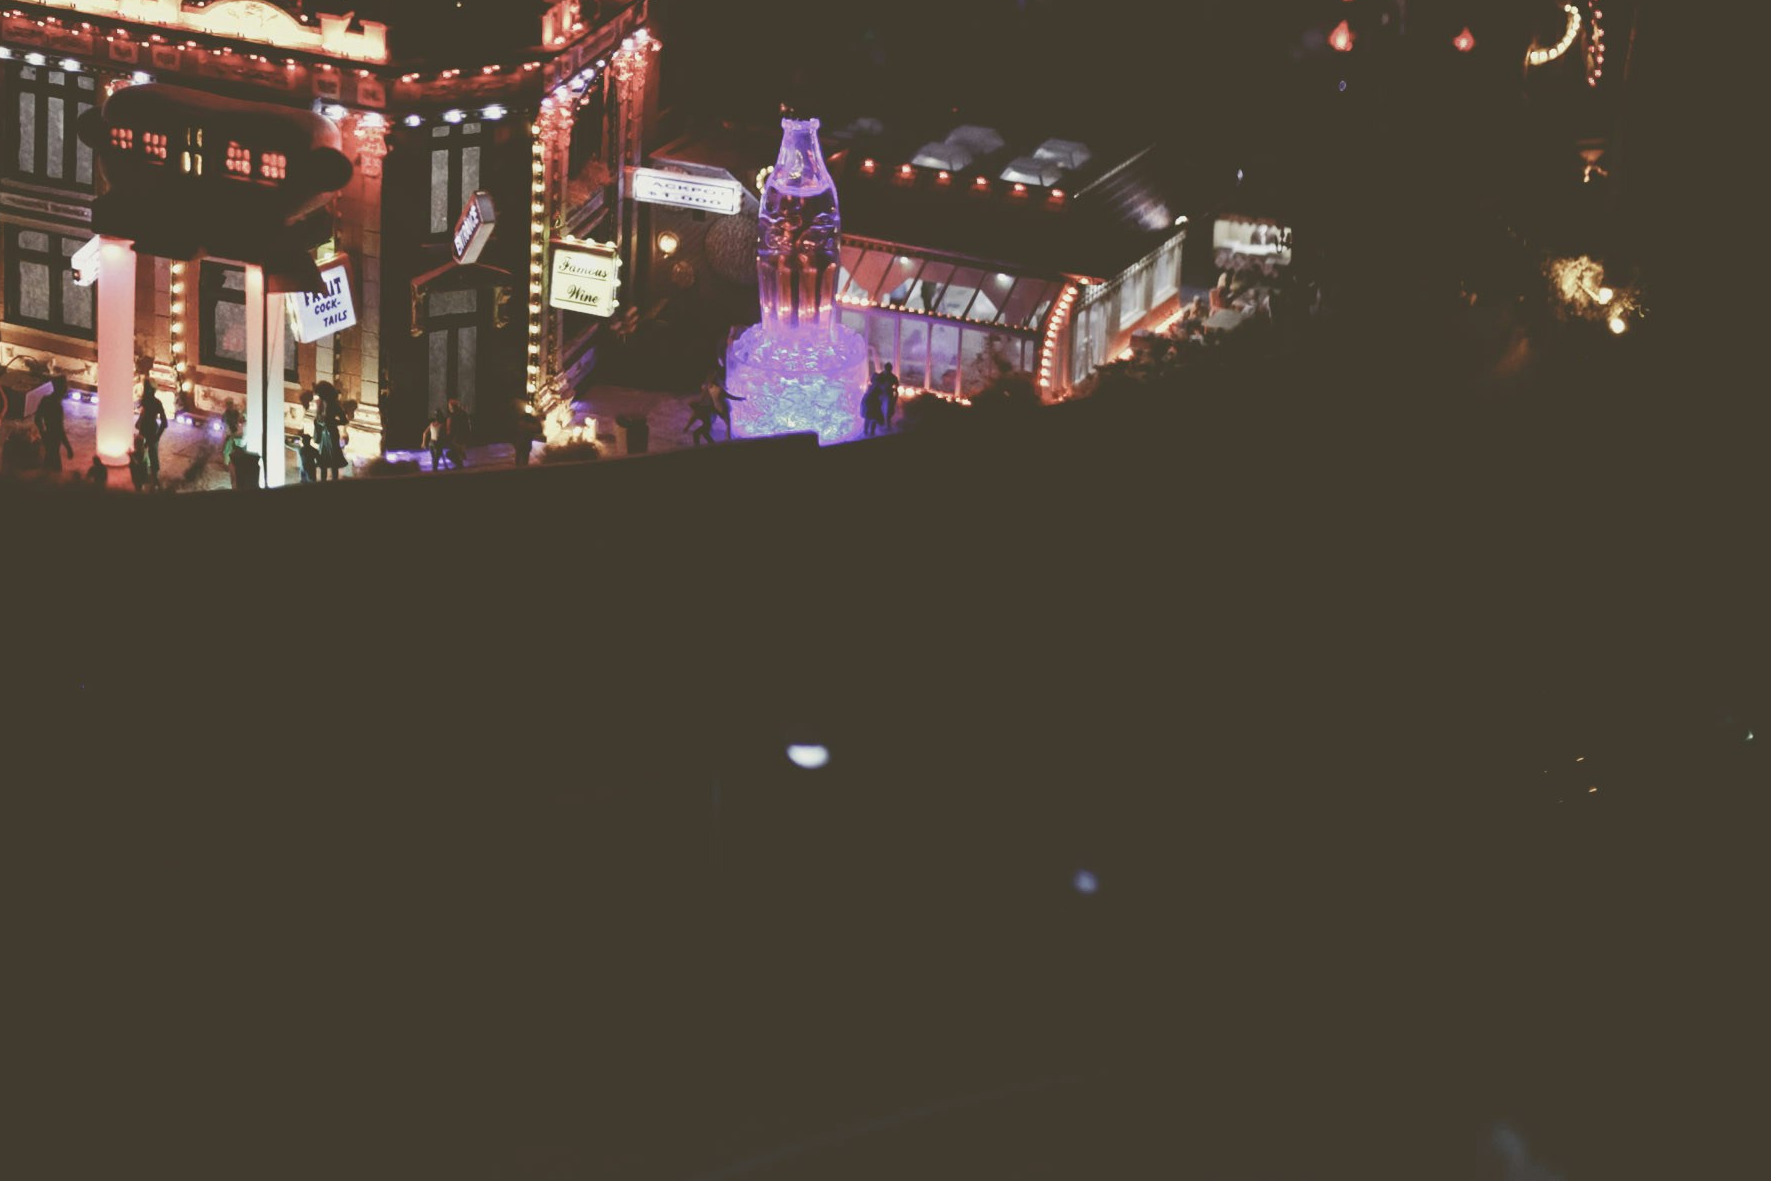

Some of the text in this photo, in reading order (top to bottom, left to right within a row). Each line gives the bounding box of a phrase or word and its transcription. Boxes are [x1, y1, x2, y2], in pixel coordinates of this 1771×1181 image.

[559, 256, 608, 278] Famous
[567, 284, 600, 304] Wine
[314, 299, 341, 315] COCK-
[323, 310, 348, 328] TAILS
